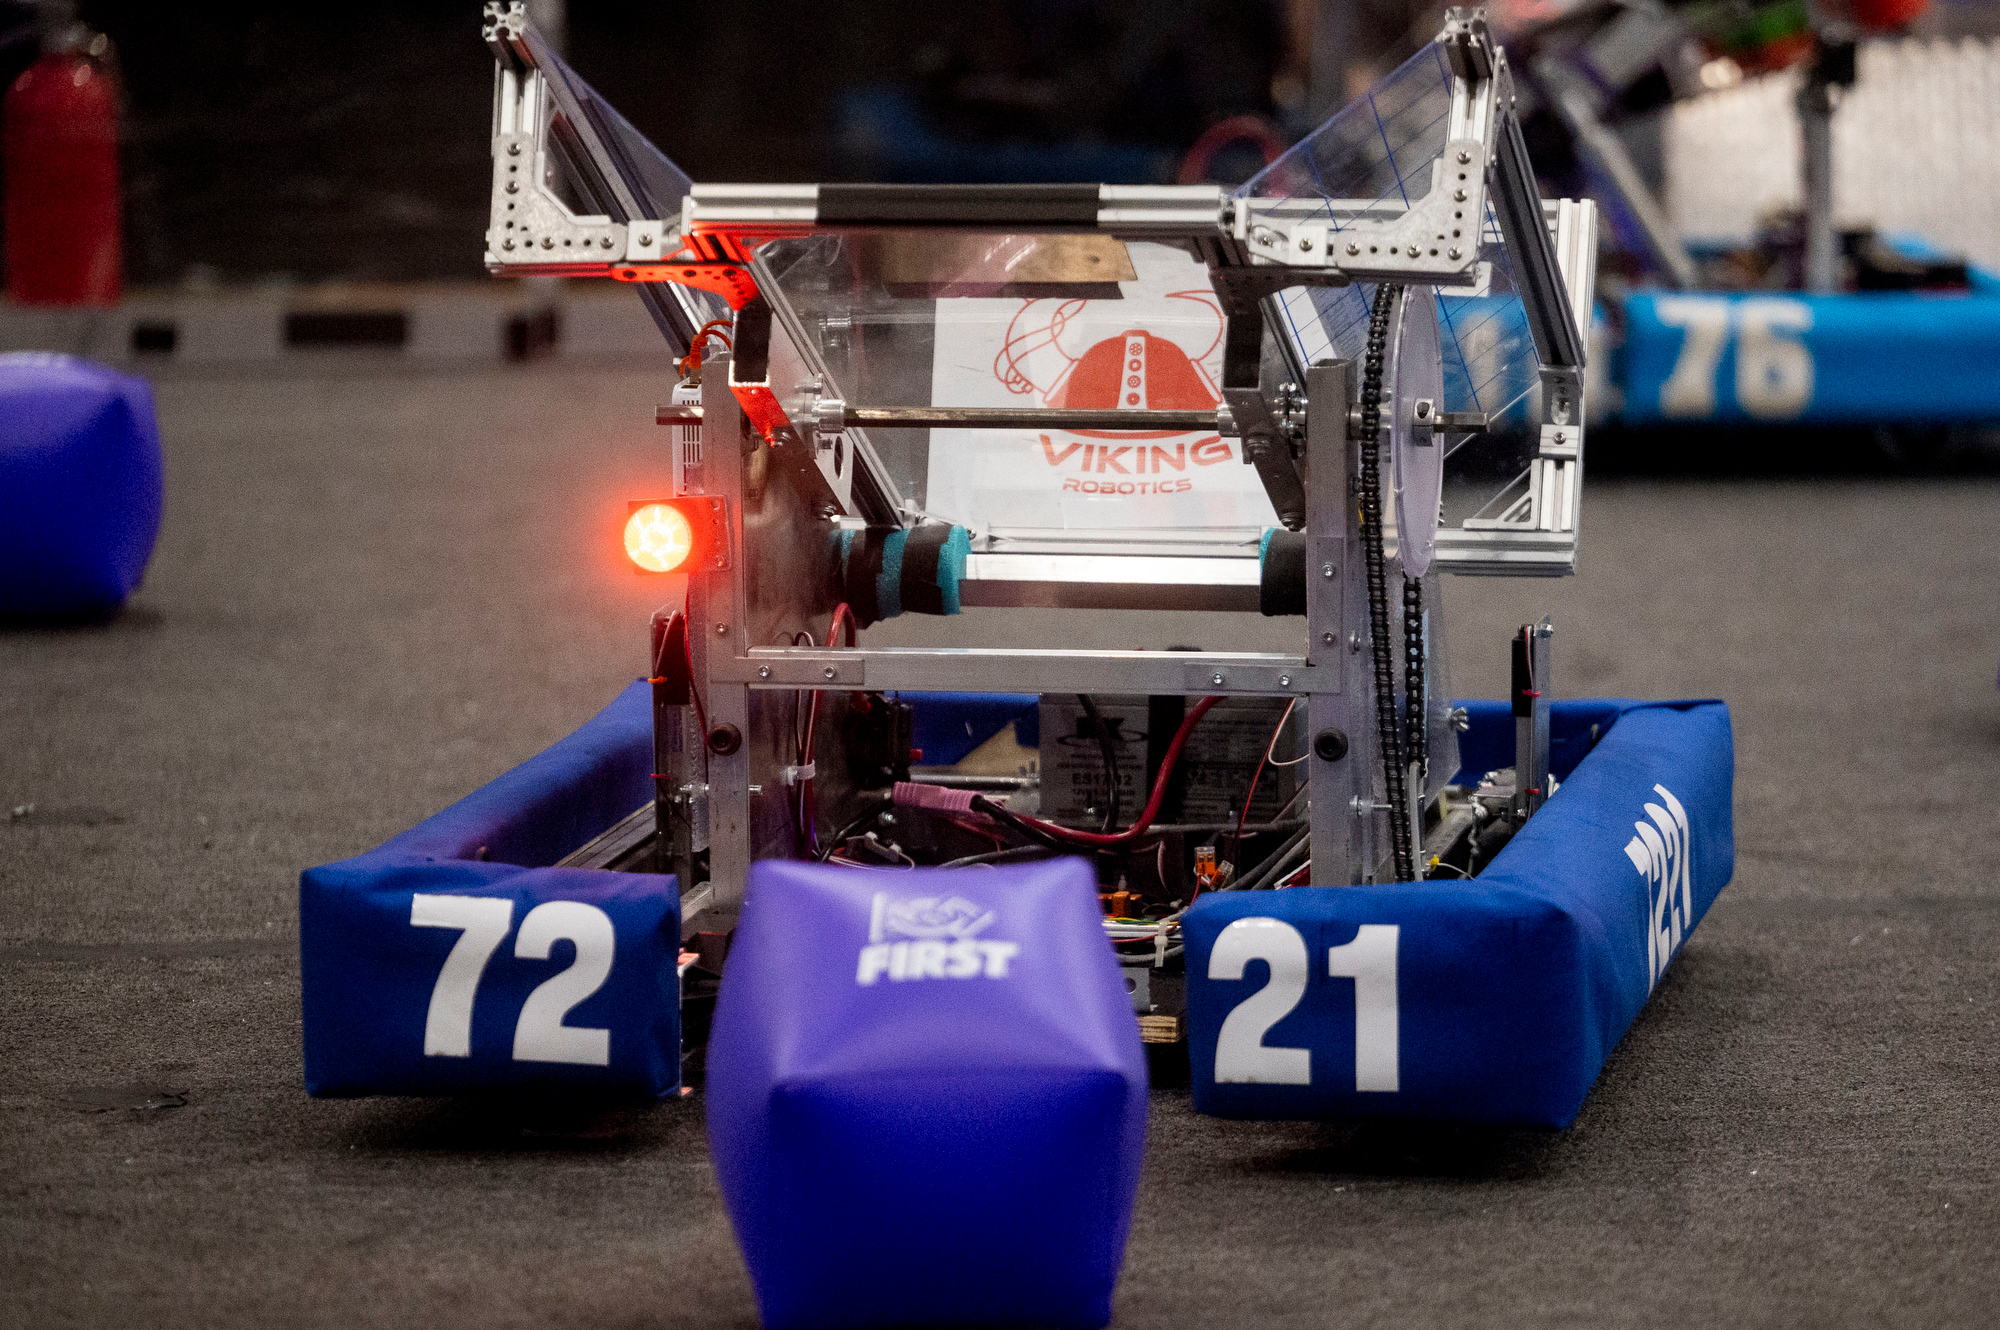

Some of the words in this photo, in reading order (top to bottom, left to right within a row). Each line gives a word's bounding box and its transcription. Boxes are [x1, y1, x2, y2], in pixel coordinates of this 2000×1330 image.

[1656, 297, 1816, 420] 76
[1039, 433, 1234, 475] VIKING
[1062, 478, 1193, 495] ROBOTICS
[1624, 783, 1692, 998] 7221
[410, 893, 615, 1066] 72
[856, 940, 1019, 987] FIRST
[1208, 916, 1401, 1092] 21
